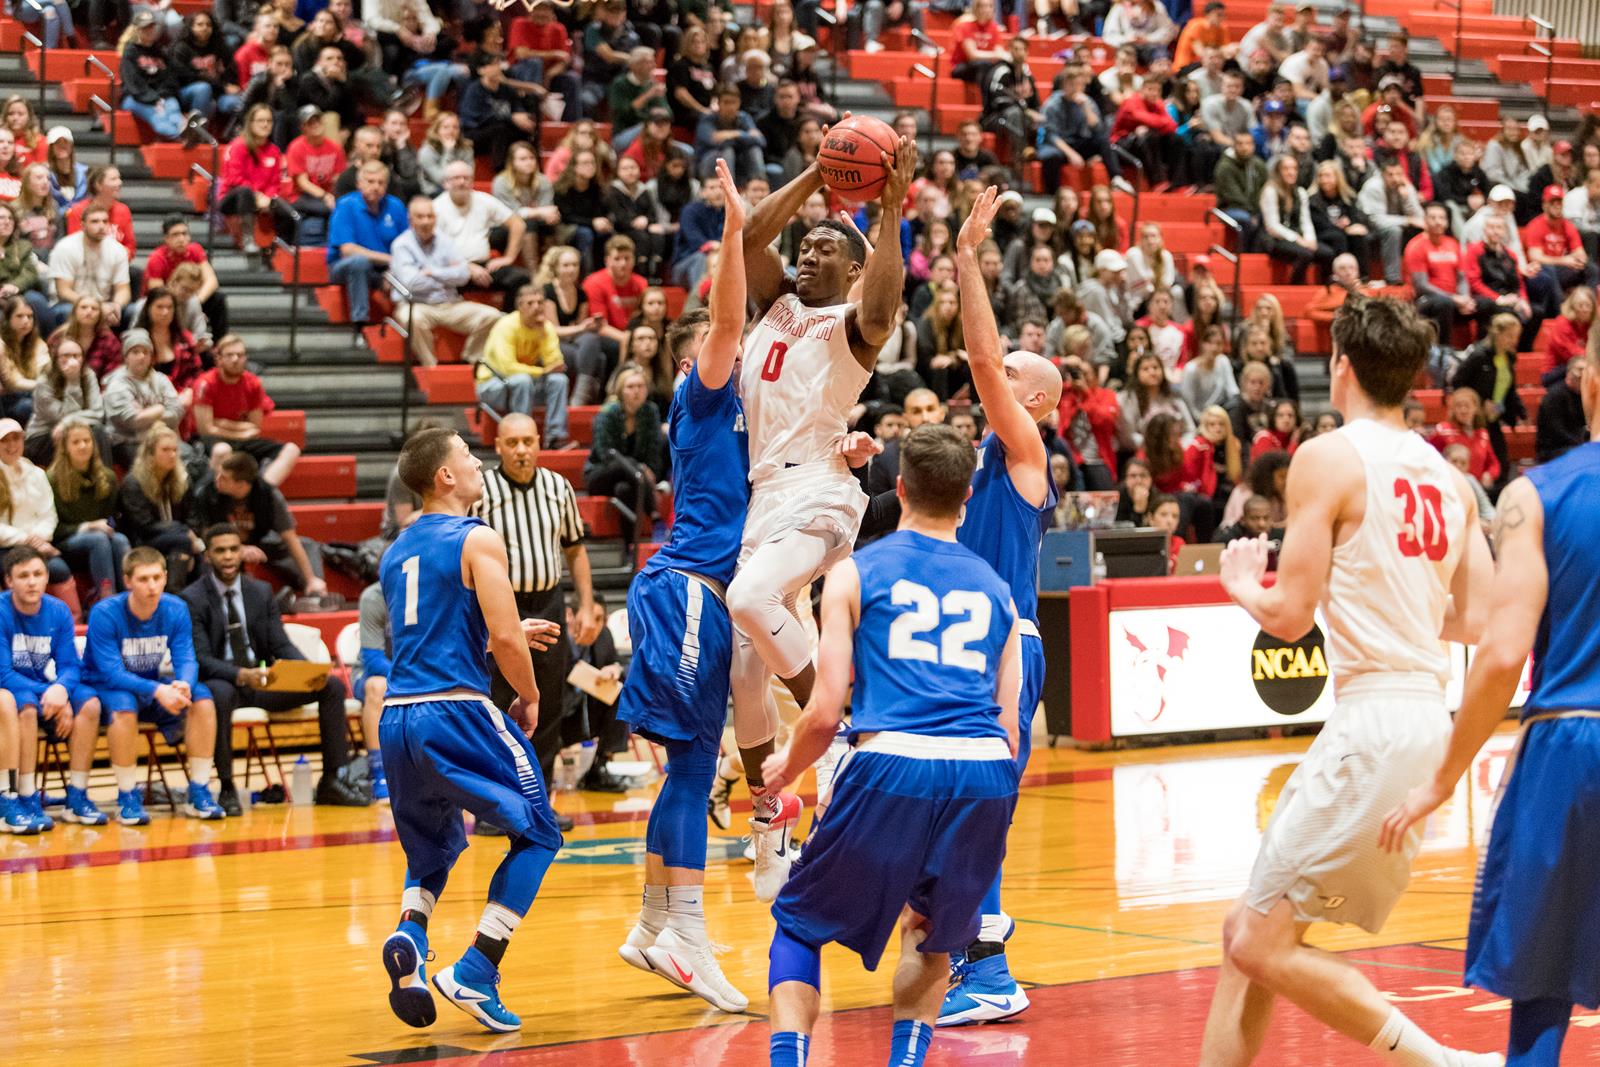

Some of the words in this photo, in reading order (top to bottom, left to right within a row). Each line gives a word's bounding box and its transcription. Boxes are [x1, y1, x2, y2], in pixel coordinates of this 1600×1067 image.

[760, 339, 788, 382] 0
[1394, 478, 1448, 561] 30
[401, 555, 420, 626] 1
[888, 579, 992, 674] 22
[1252, 645, 1329, 681] NCAA
